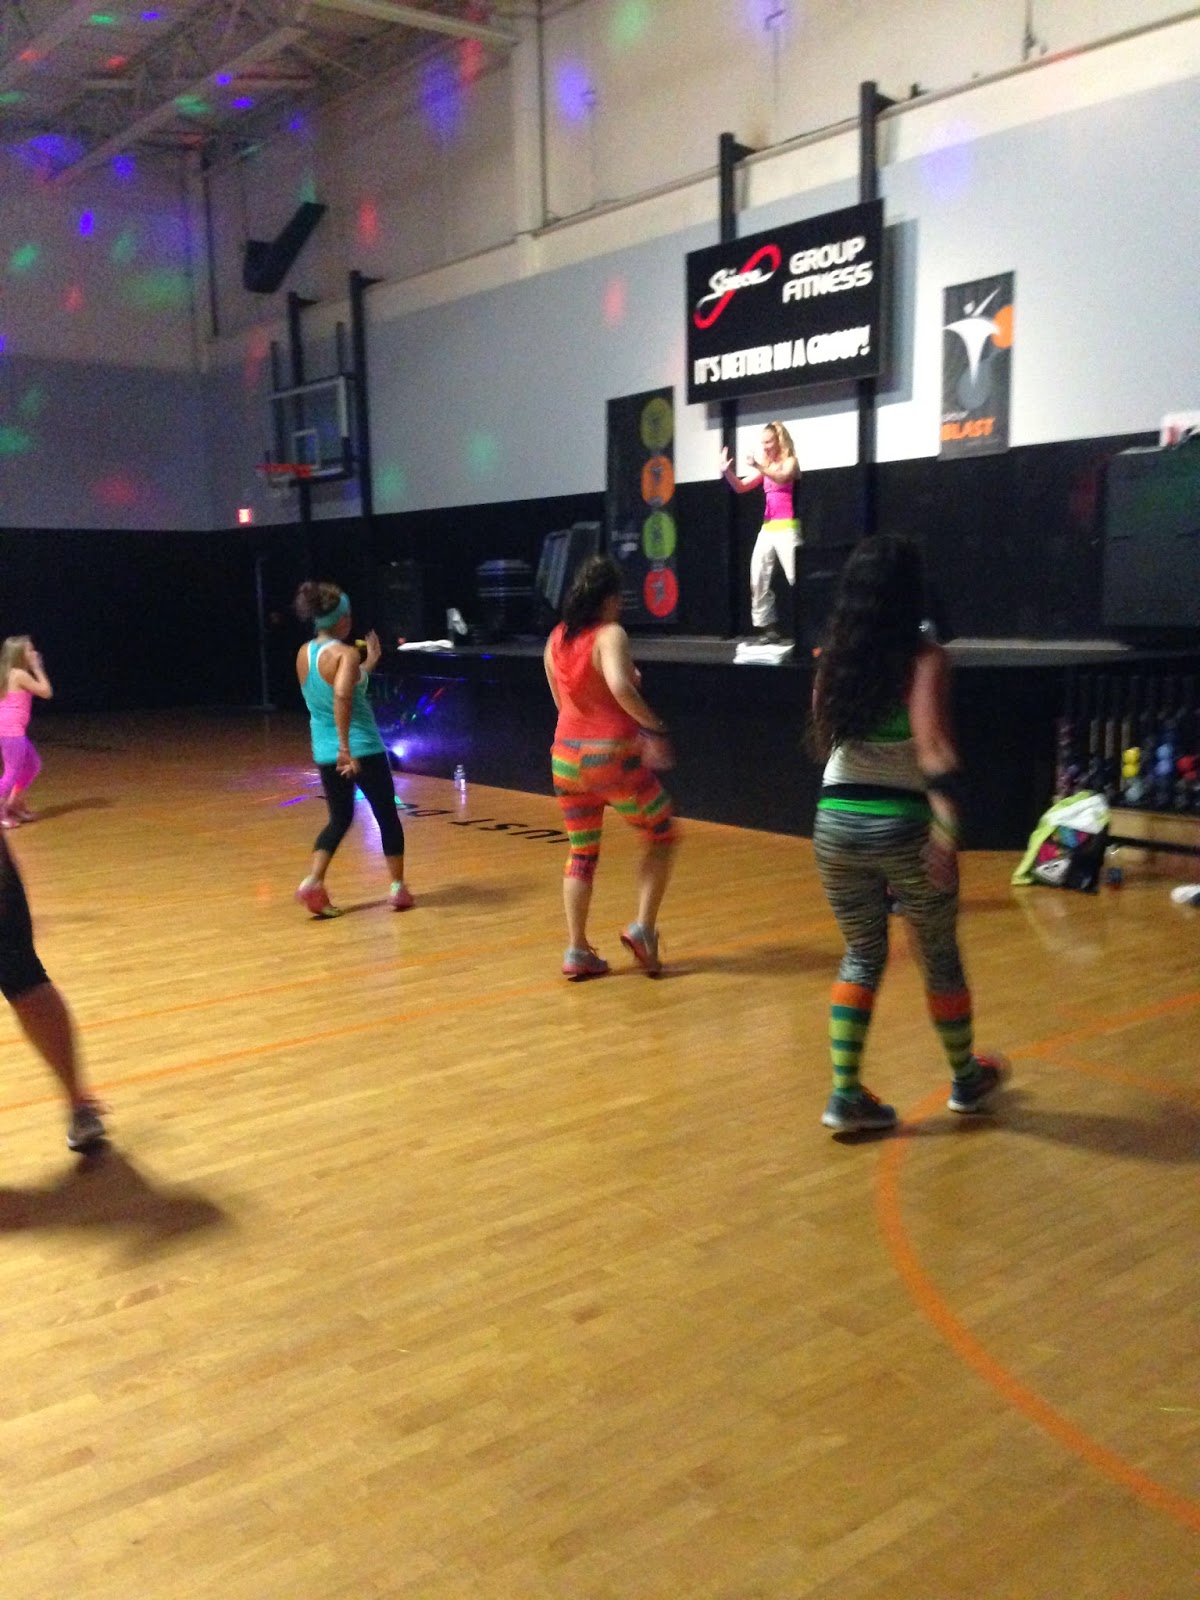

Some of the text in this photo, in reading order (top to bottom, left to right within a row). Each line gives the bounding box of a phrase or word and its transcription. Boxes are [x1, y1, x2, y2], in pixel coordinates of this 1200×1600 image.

[788, 236, 866, 276] GROUP
[782, 261, 874, 304] FITNESS
[792, 338, 807, 368] A
